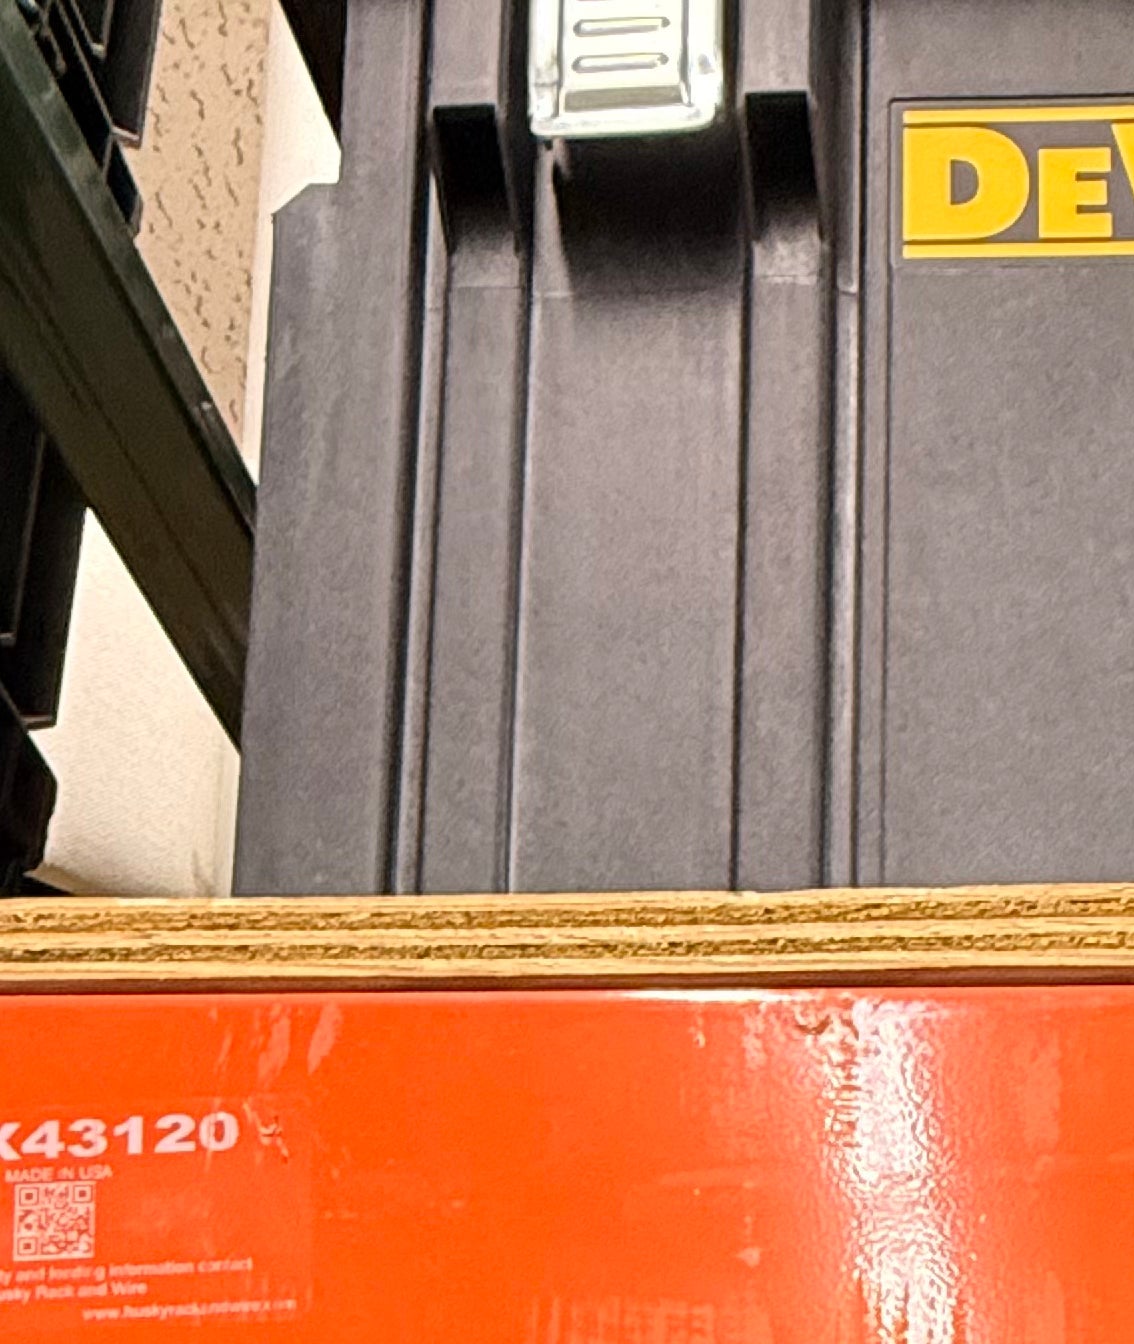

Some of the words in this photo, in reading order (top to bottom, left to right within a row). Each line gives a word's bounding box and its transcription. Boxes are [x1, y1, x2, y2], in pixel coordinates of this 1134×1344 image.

[5, 1167, 53, 1182] MADE
[79, 1164, 112, 1179] USA
[111, 1281, 147, 1296] Wire
